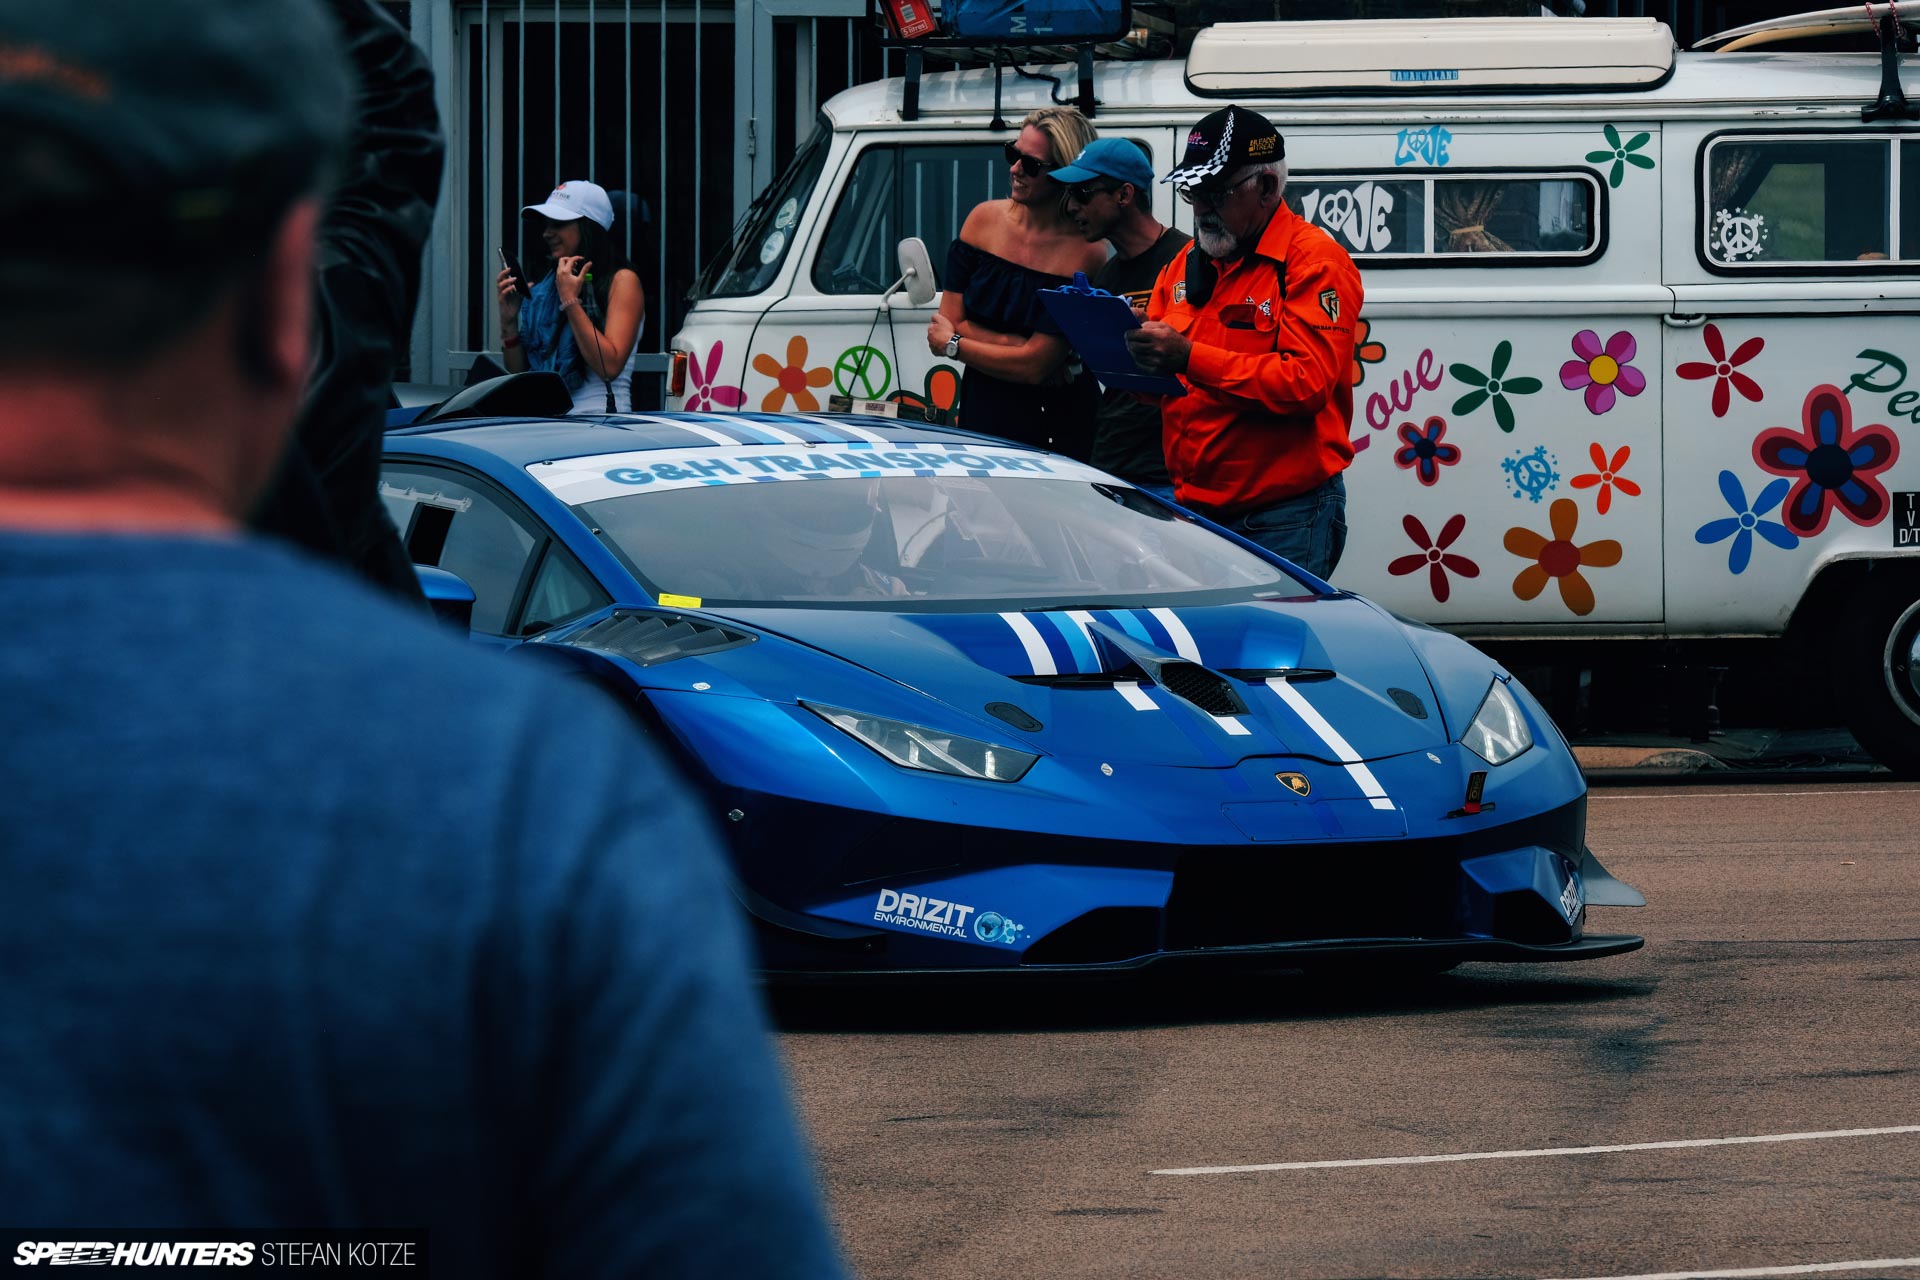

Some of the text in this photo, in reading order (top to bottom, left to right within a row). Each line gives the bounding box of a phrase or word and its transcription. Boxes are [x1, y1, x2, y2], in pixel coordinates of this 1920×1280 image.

[902, 22, 926, 36] 5 litres
[1395, 124, 1453, 167] LOVE
[1351, 348, 1444, 454] ove
[604, 452, 1055, 487] G&H TRANSPORT
[1906, 493, 1915, 509] T
[1906, 510, 1916, 527] V
[876, 888, 975, 928] DRIZIT
[873, 911, 968, 938] ENVIRONMENTAL
